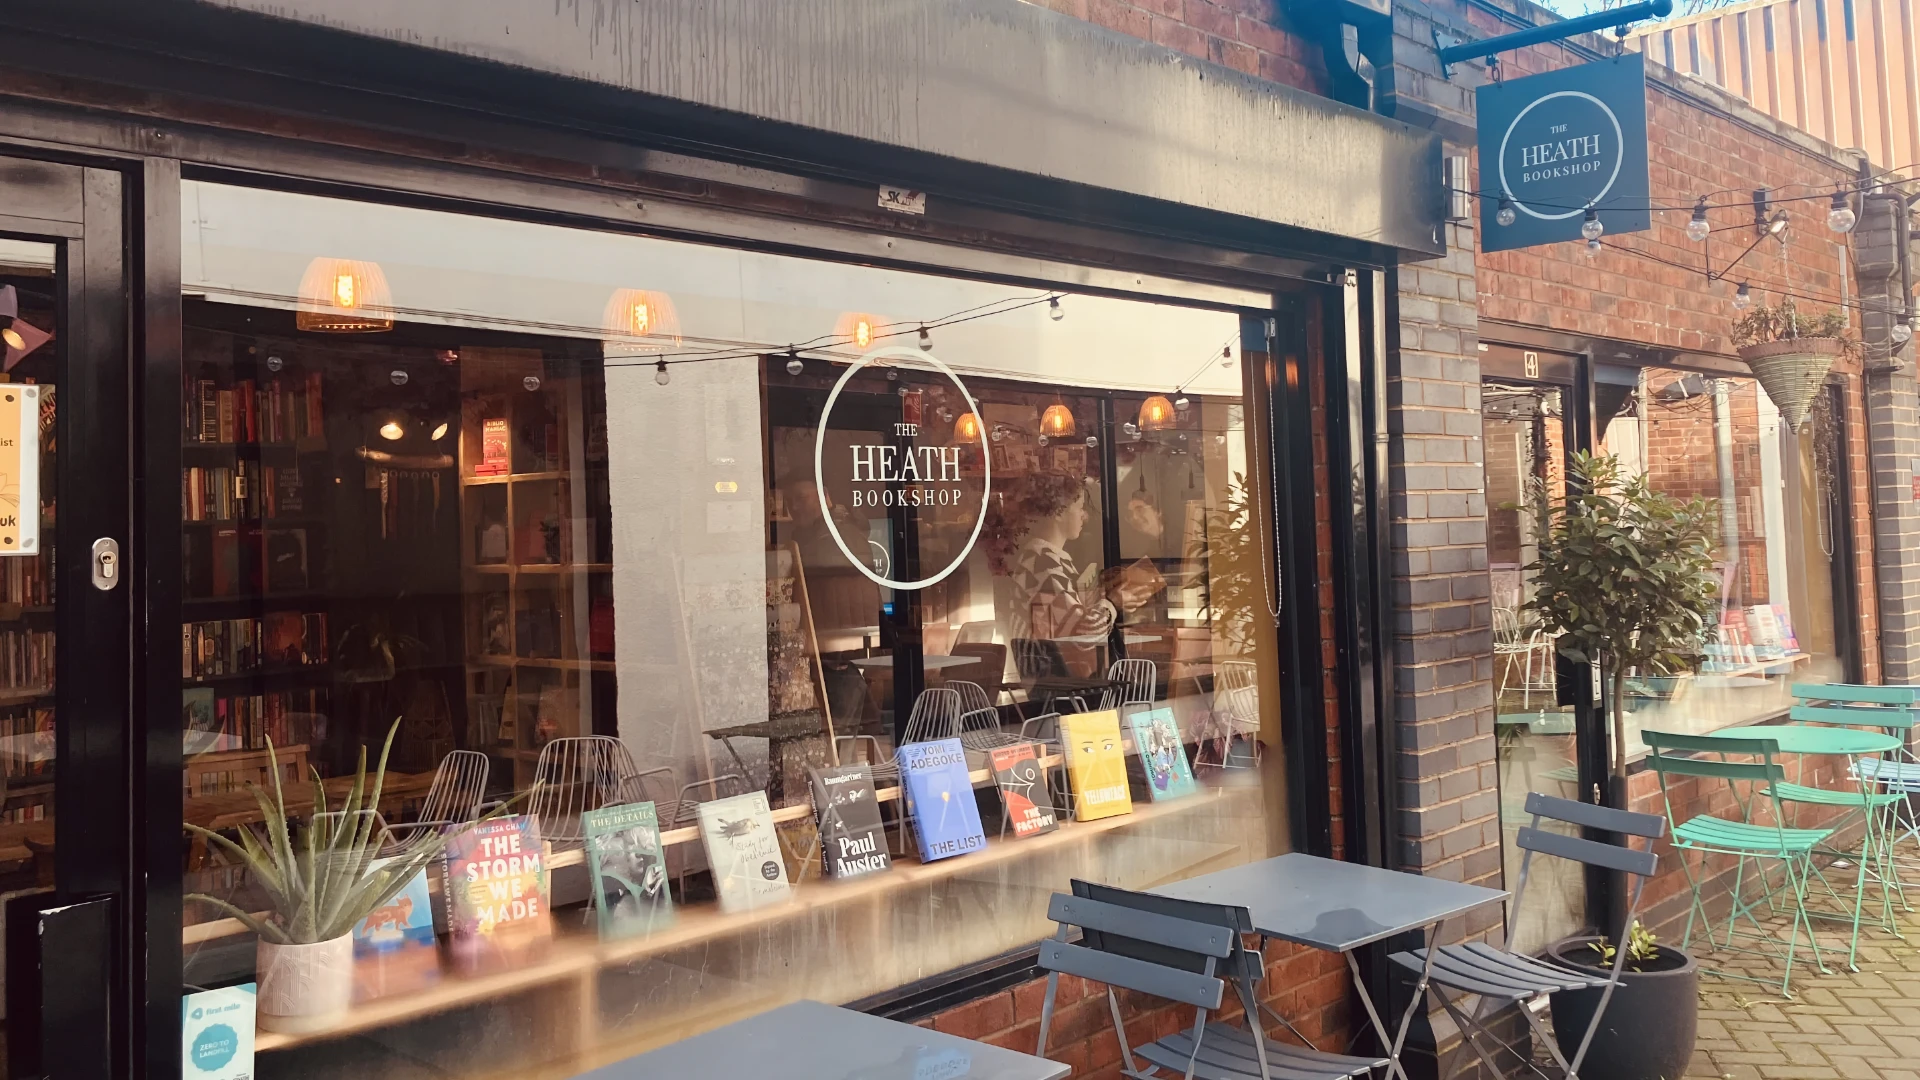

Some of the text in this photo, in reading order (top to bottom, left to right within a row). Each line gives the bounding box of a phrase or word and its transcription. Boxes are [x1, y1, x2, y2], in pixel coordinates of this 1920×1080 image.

[1550, 123, 1568, 134] THE
[1521, 134, 1601, 168] HEATH
[1523, 160, 1601, 183] BOOKSHOP
[1527, 354, 1536, 376] 4
[894, 423, 918, 436] THE
[849, 445, 962, 482] HEATH
[852, 489, 962, 507] BOOKSHOP
[921, 744, 945, 756] YOMI
[910, 753, 964, 770] ADEGOKE
[823, 772, 862, 786] Baumgartner
[1083, 784, 1126, 806] YELLOWFACE
[590, 817, 611, 828] THE
[614, 810, 654, 824] DETAILS
[1023, 806, 1041, 818] THE
[473, 826, 504, 835] VANESSA
[1015, 814, 1053, 832] FACTORY
[480, 834, 521, 858] THE
[838, 831, 877, 858] Paul
[930, 840, 956, 855] THE
[957, 834, 983, 850] LIST
[466, 853, 541, 882] STORM
[837, 852, 887, 879] Auster
[487, 877, 523, 901] WE
[476, 897, 539, 925] MADE
[199, 1041, 219, 1052] ZERO
